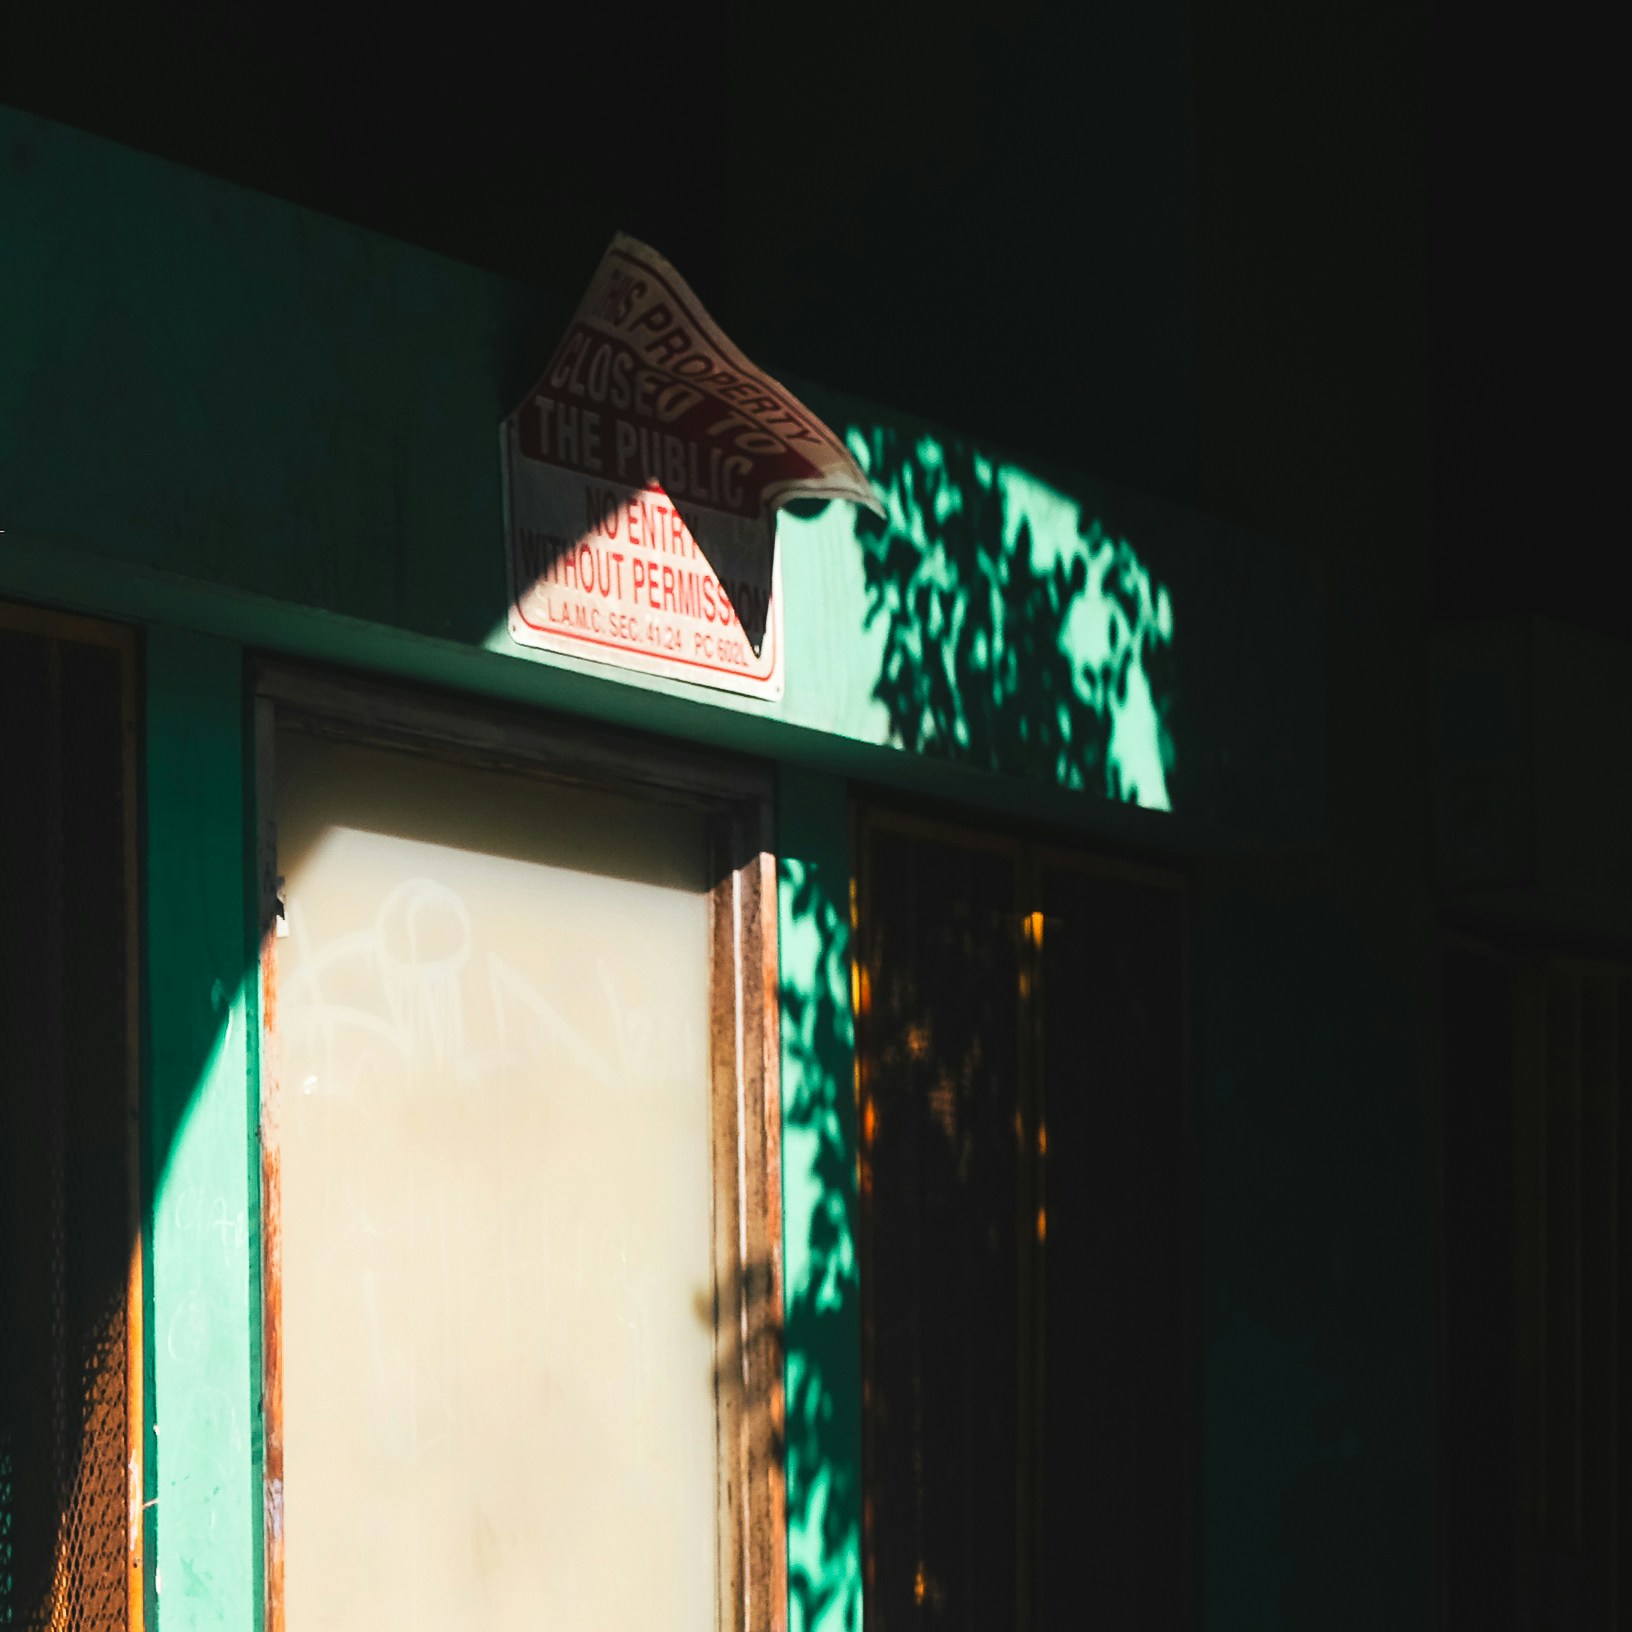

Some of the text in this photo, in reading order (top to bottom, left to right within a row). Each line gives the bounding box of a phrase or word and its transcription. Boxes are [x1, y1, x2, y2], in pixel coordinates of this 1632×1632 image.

[550, 333, 788, 456] CLOSED TO
[628, 303, 822, 444] PROPERTY
[533, 395, 754, 509] THE PUBLIC
[586, 486, 699, 560] NO ENTRY
[519, 526, 772, 635] WITHOUT PERMISSION
[694, 632, 714, 658] PC
